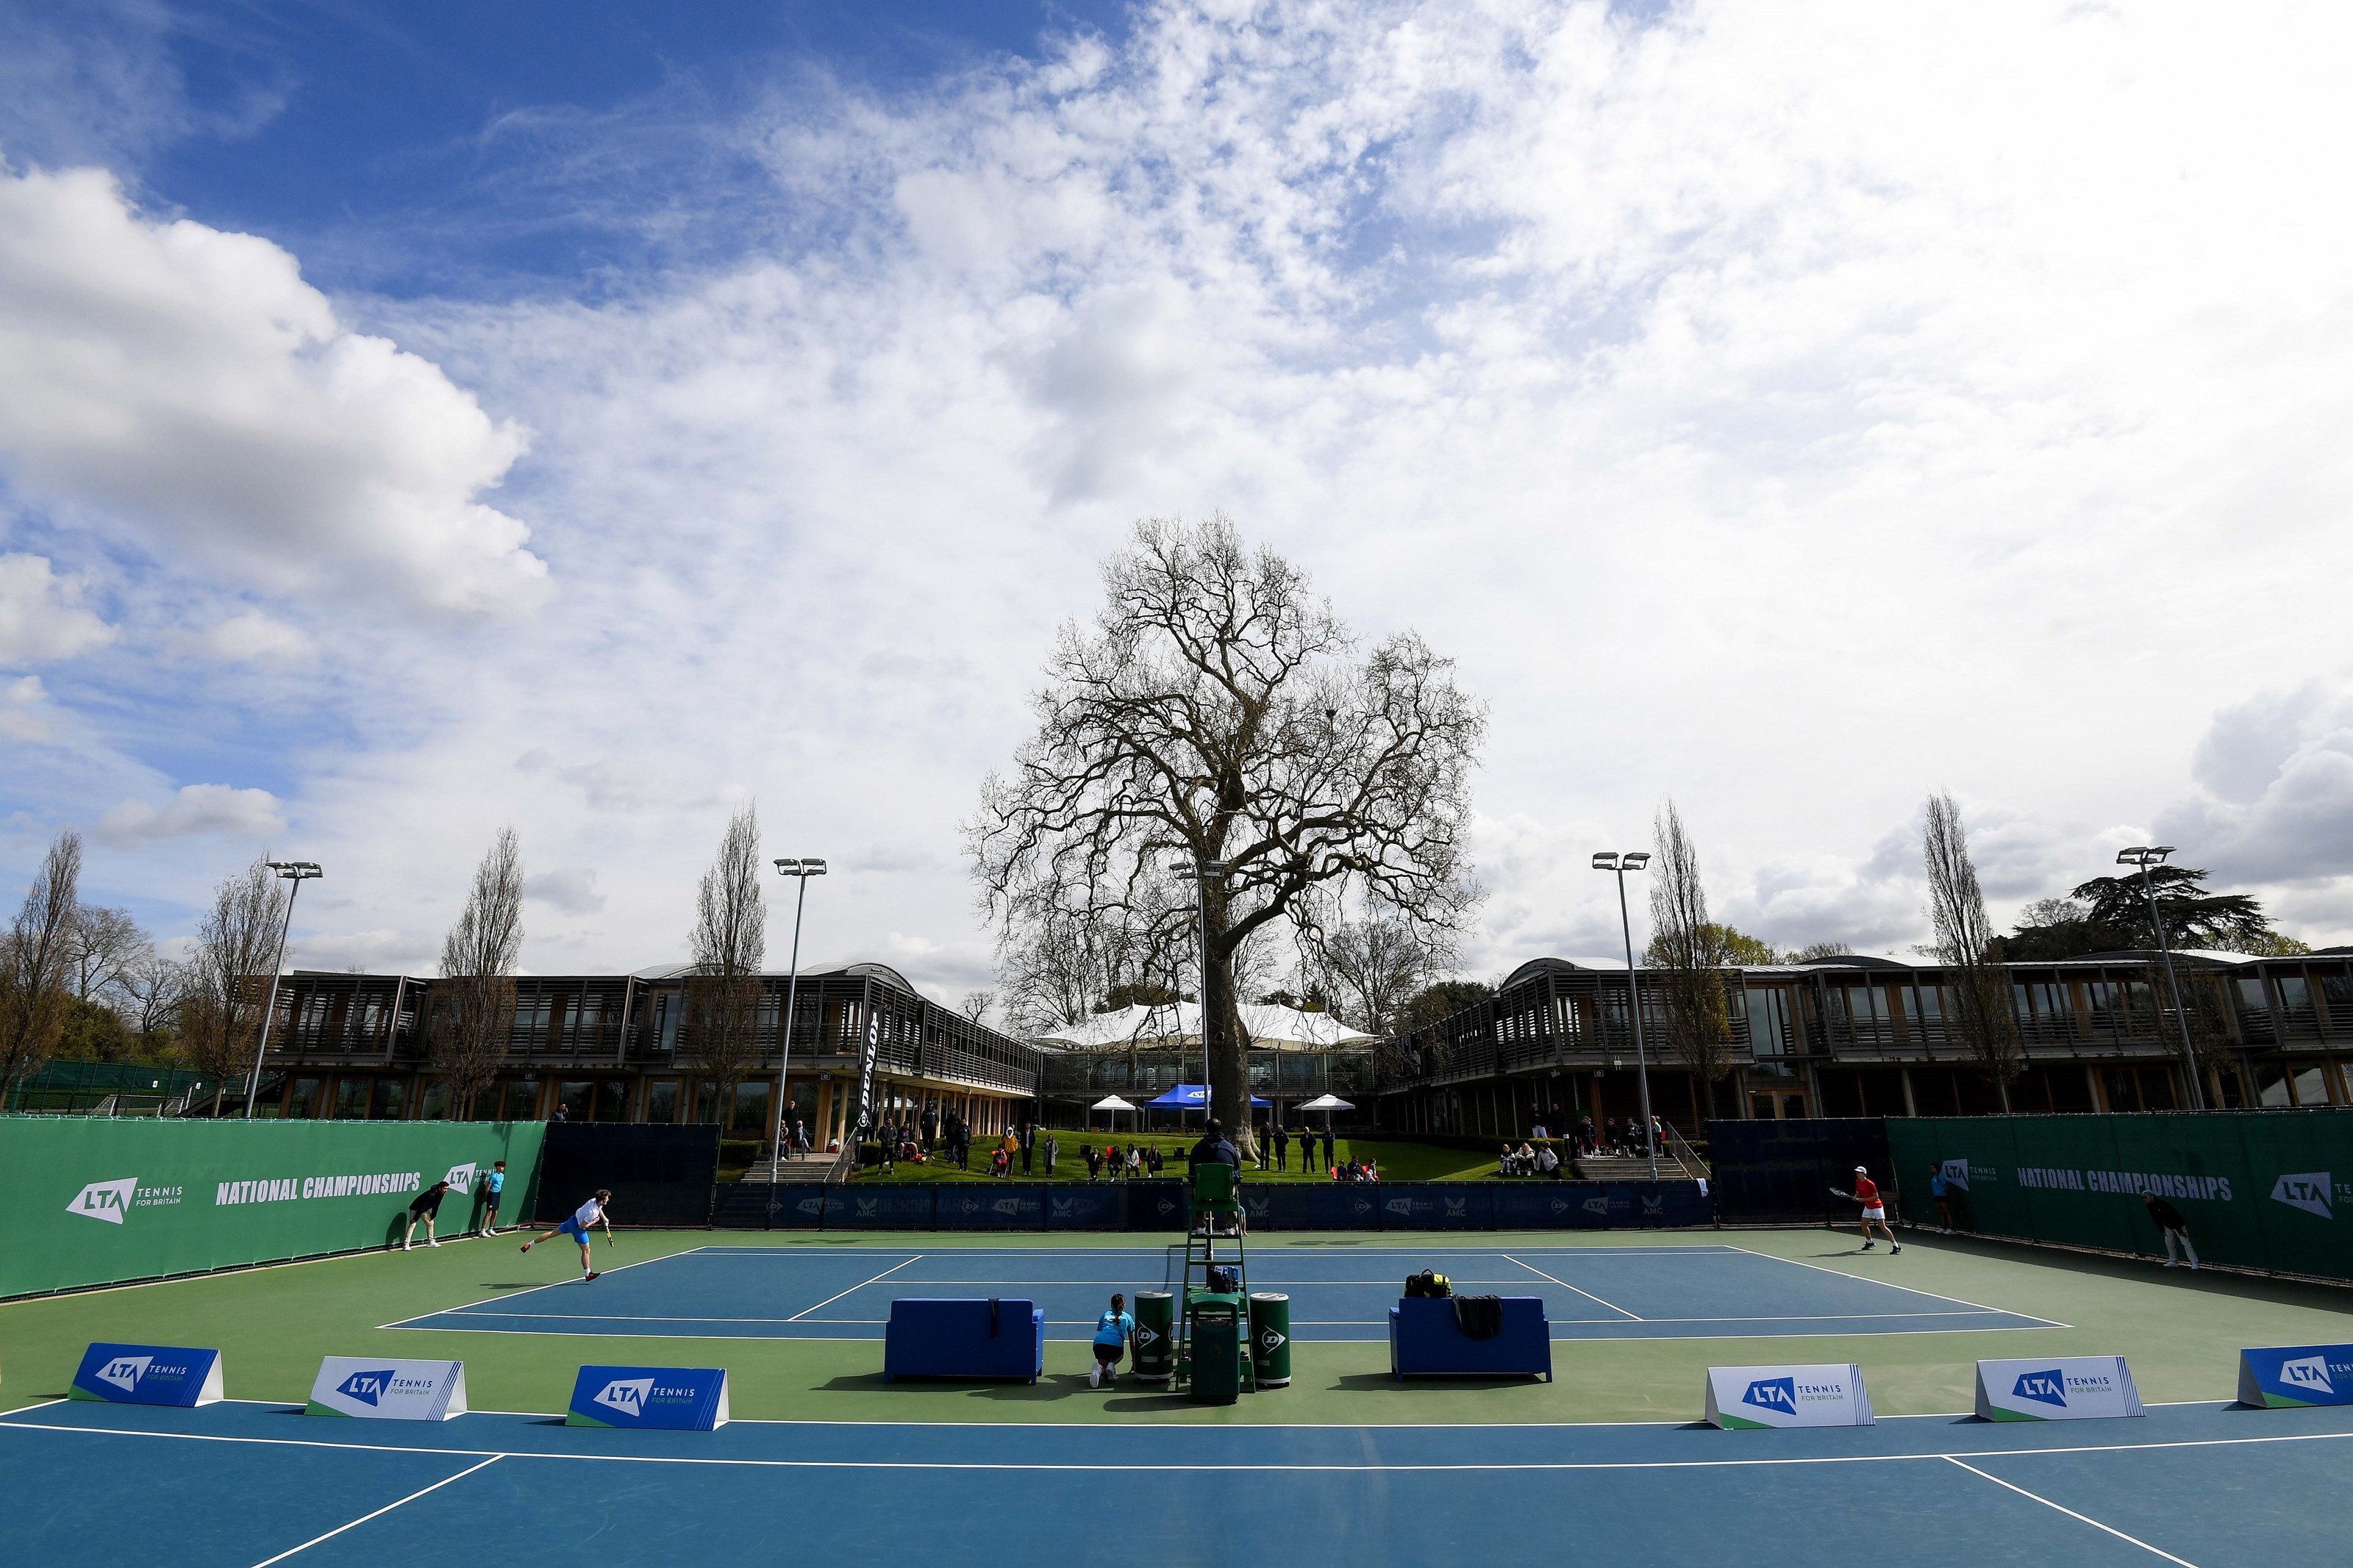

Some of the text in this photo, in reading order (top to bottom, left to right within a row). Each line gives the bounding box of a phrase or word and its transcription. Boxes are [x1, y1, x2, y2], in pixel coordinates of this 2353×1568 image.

[862, 1012, 879, 1109] DUNLOP
[1969, 1167, 1996, 1175] TENNIS
[2017, 1167, 2232, 1200] NATIONAL CHAMPIONSHIPS
[137, 1186, 183, 1198] TENNIS
[215, 1172, 421, 1206] NATIONAL CHAMPIONSHIPS
[153, 1198, 181, 1206] BRITAIN
[856, 1209, 876, 1217] AMC
[1052, 1209, 1072, 1217] AMC
[1249, 1209, 1269, 1217] AMC
[1446, 1209, 1466, 1217] AMC
[1643, 1207, 1663, 1215] AMC
[149, 1365, 187, 1375] TENNIS
[393, 1379, 433, 1388] TENNIS
[2065, 1376, 2110, 1386] TENNIS
[653, 1388, 695, 1397] TENNIS
[1797, 1385, 1841, 1394] TENNIS
